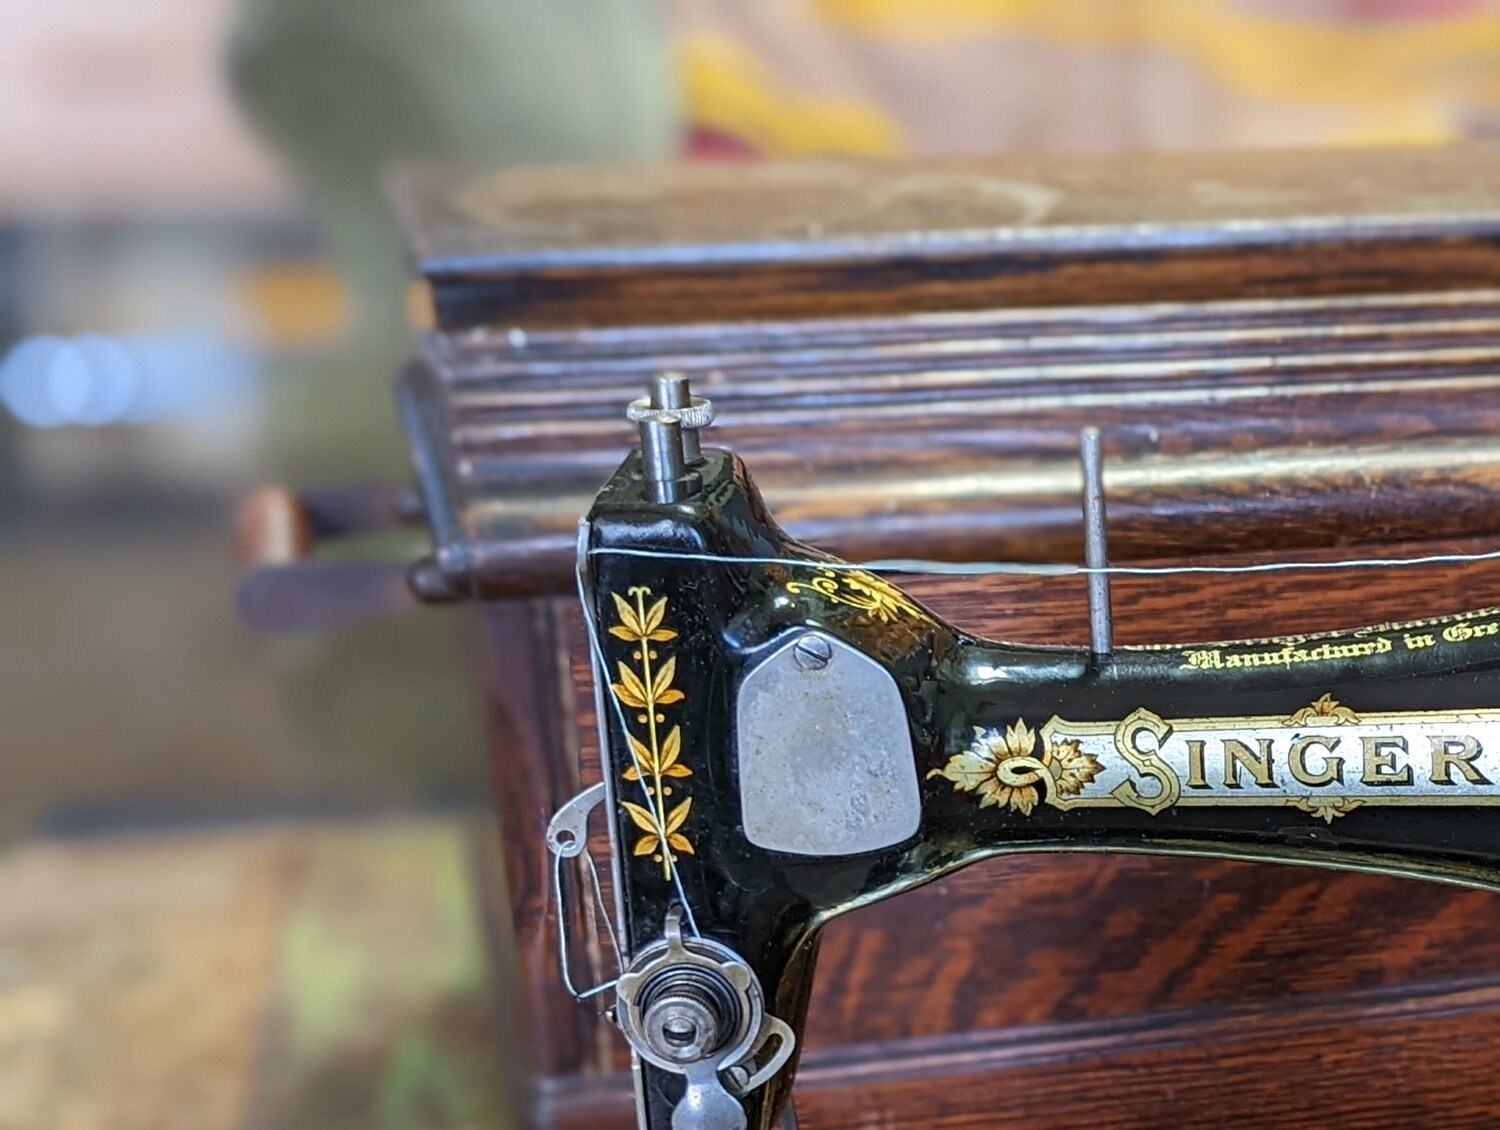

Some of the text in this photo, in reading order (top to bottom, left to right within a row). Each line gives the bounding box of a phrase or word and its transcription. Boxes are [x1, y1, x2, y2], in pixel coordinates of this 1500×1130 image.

[1179, 636, 1393, 671] Manufactured
[1403, 632, 1437, 650] in
[1110, 706, 1494, 816] SINGER
